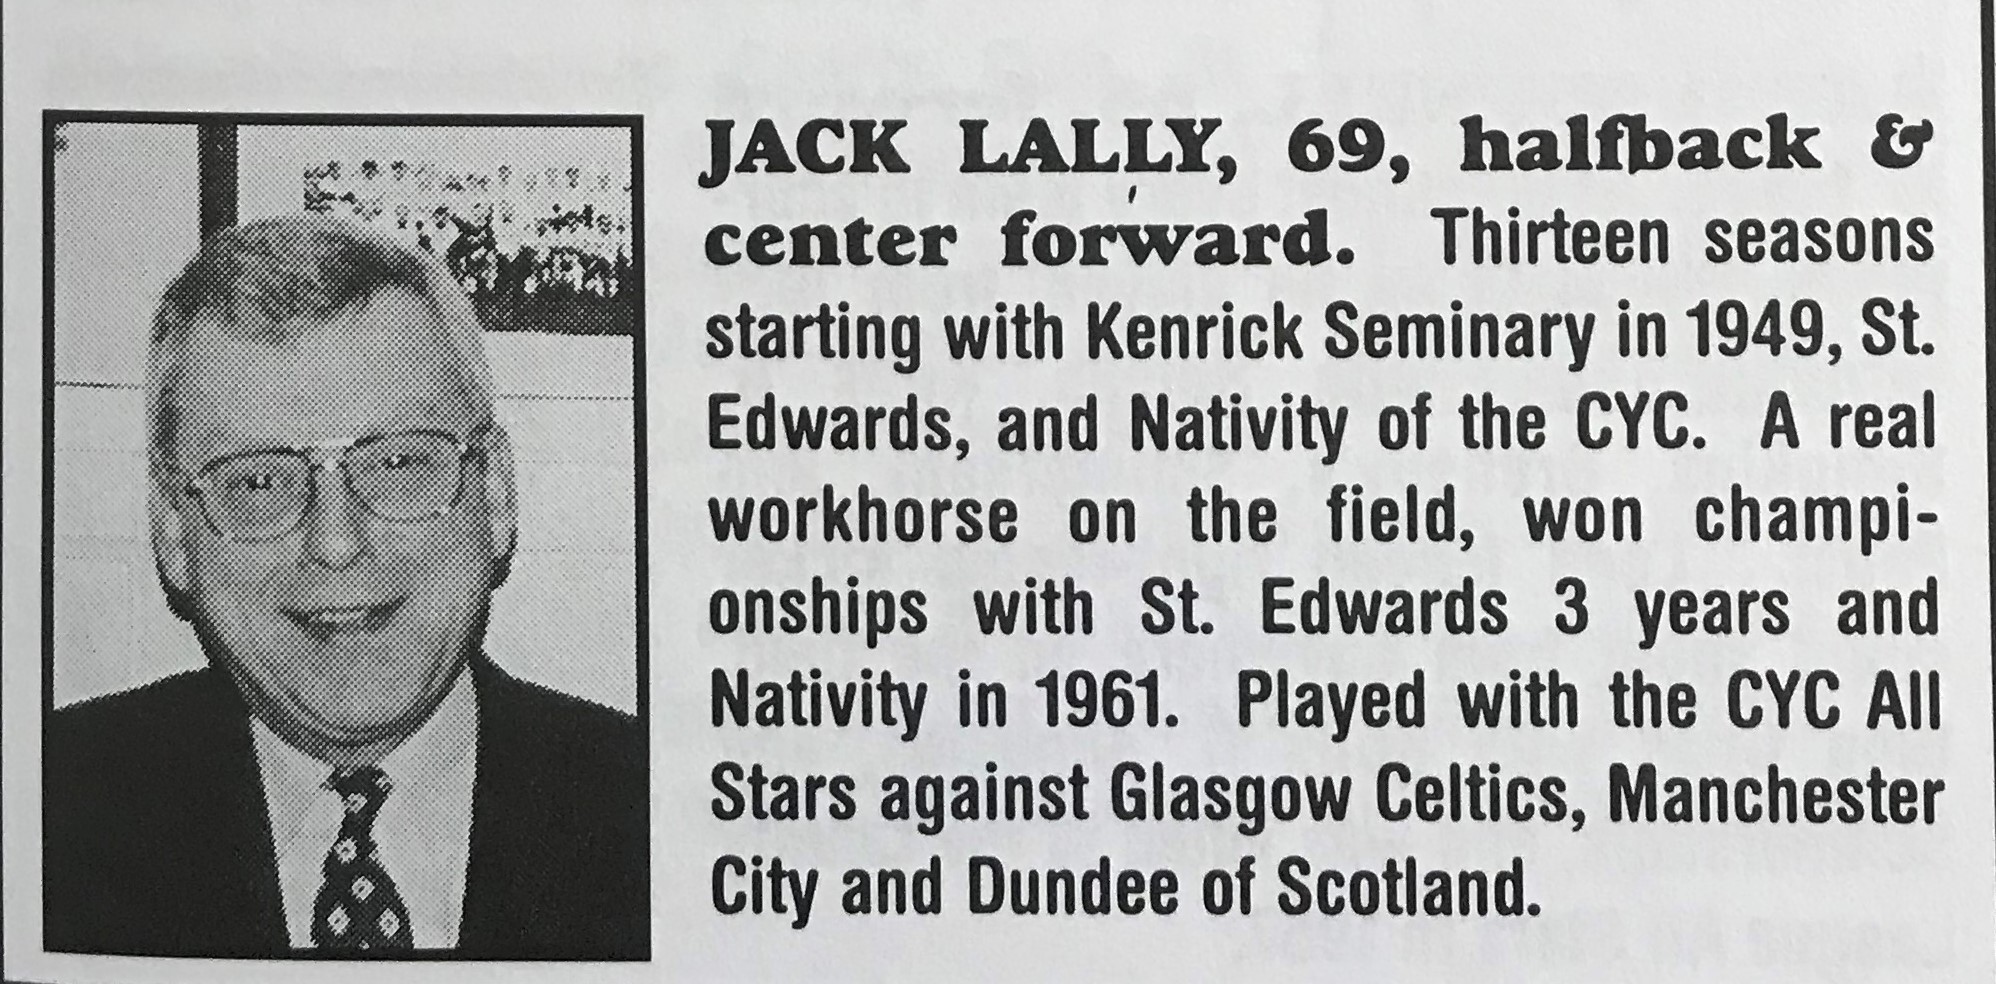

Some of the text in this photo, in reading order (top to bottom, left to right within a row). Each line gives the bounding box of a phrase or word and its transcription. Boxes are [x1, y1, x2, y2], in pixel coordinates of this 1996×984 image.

[697, 112, 1934, 190] JACK LALLY, 69, halfback &
[704, 205, 1934, 267] center forward. Thirteen seasons
[706, 297, 1935, 375] starting with Kenrick Seminary in 1949, St.
[708, 389, 1935, 466] Edwards, and Nativity of the CYC. A real
[707, 482, 1938, 557] workhorse on the field, won champi-
[709, 575, 1939, 650] onships with St. Edwards 3 years and
[711, 667, 1941, 744] Nativity in 1961. Played with the CYC All
[711, 760, 1946, 837] Stars against Glasgow Celtics, Manchester
[711, 854, 1541, 930] City and Dundee of Scotland.
